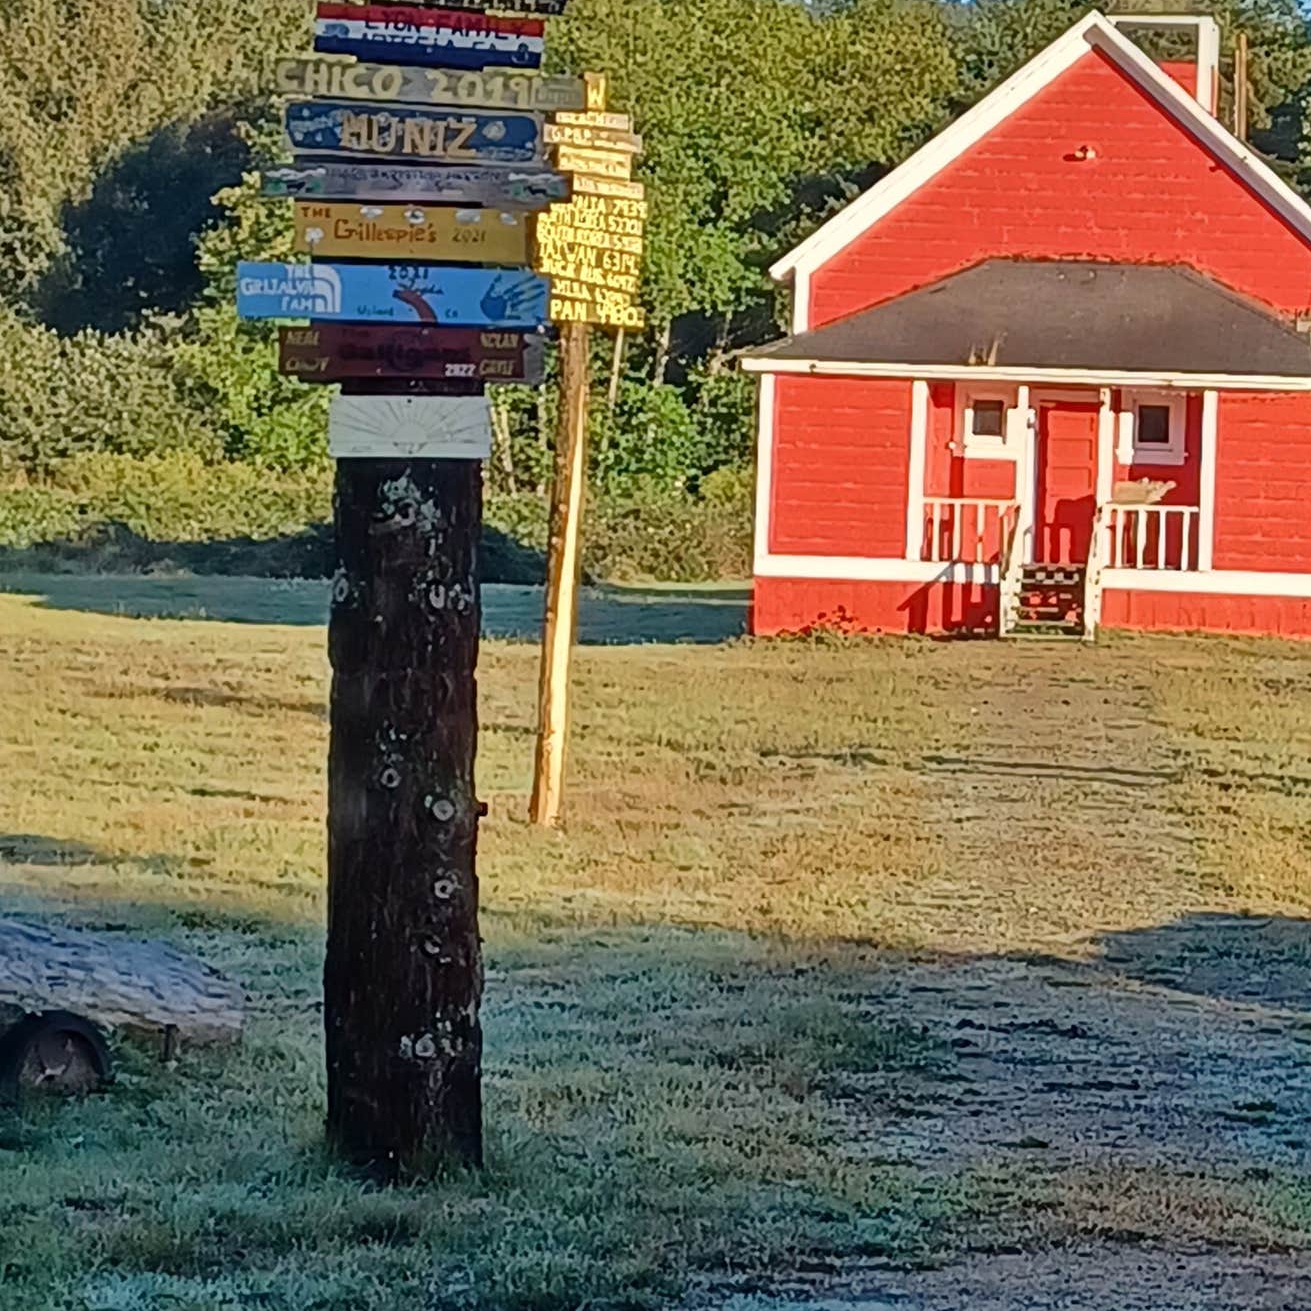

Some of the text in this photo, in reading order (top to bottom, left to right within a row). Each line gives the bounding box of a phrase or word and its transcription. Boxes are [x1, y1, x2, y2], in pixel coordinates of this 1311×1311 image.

[275, 59, 400, 97] CHICO
[426, 68, 534, 107] 2019
[587, 77, 606, 106] W
[300, 206, 332, 219] THE
[540, 241, 597, 266] TAIWAN
